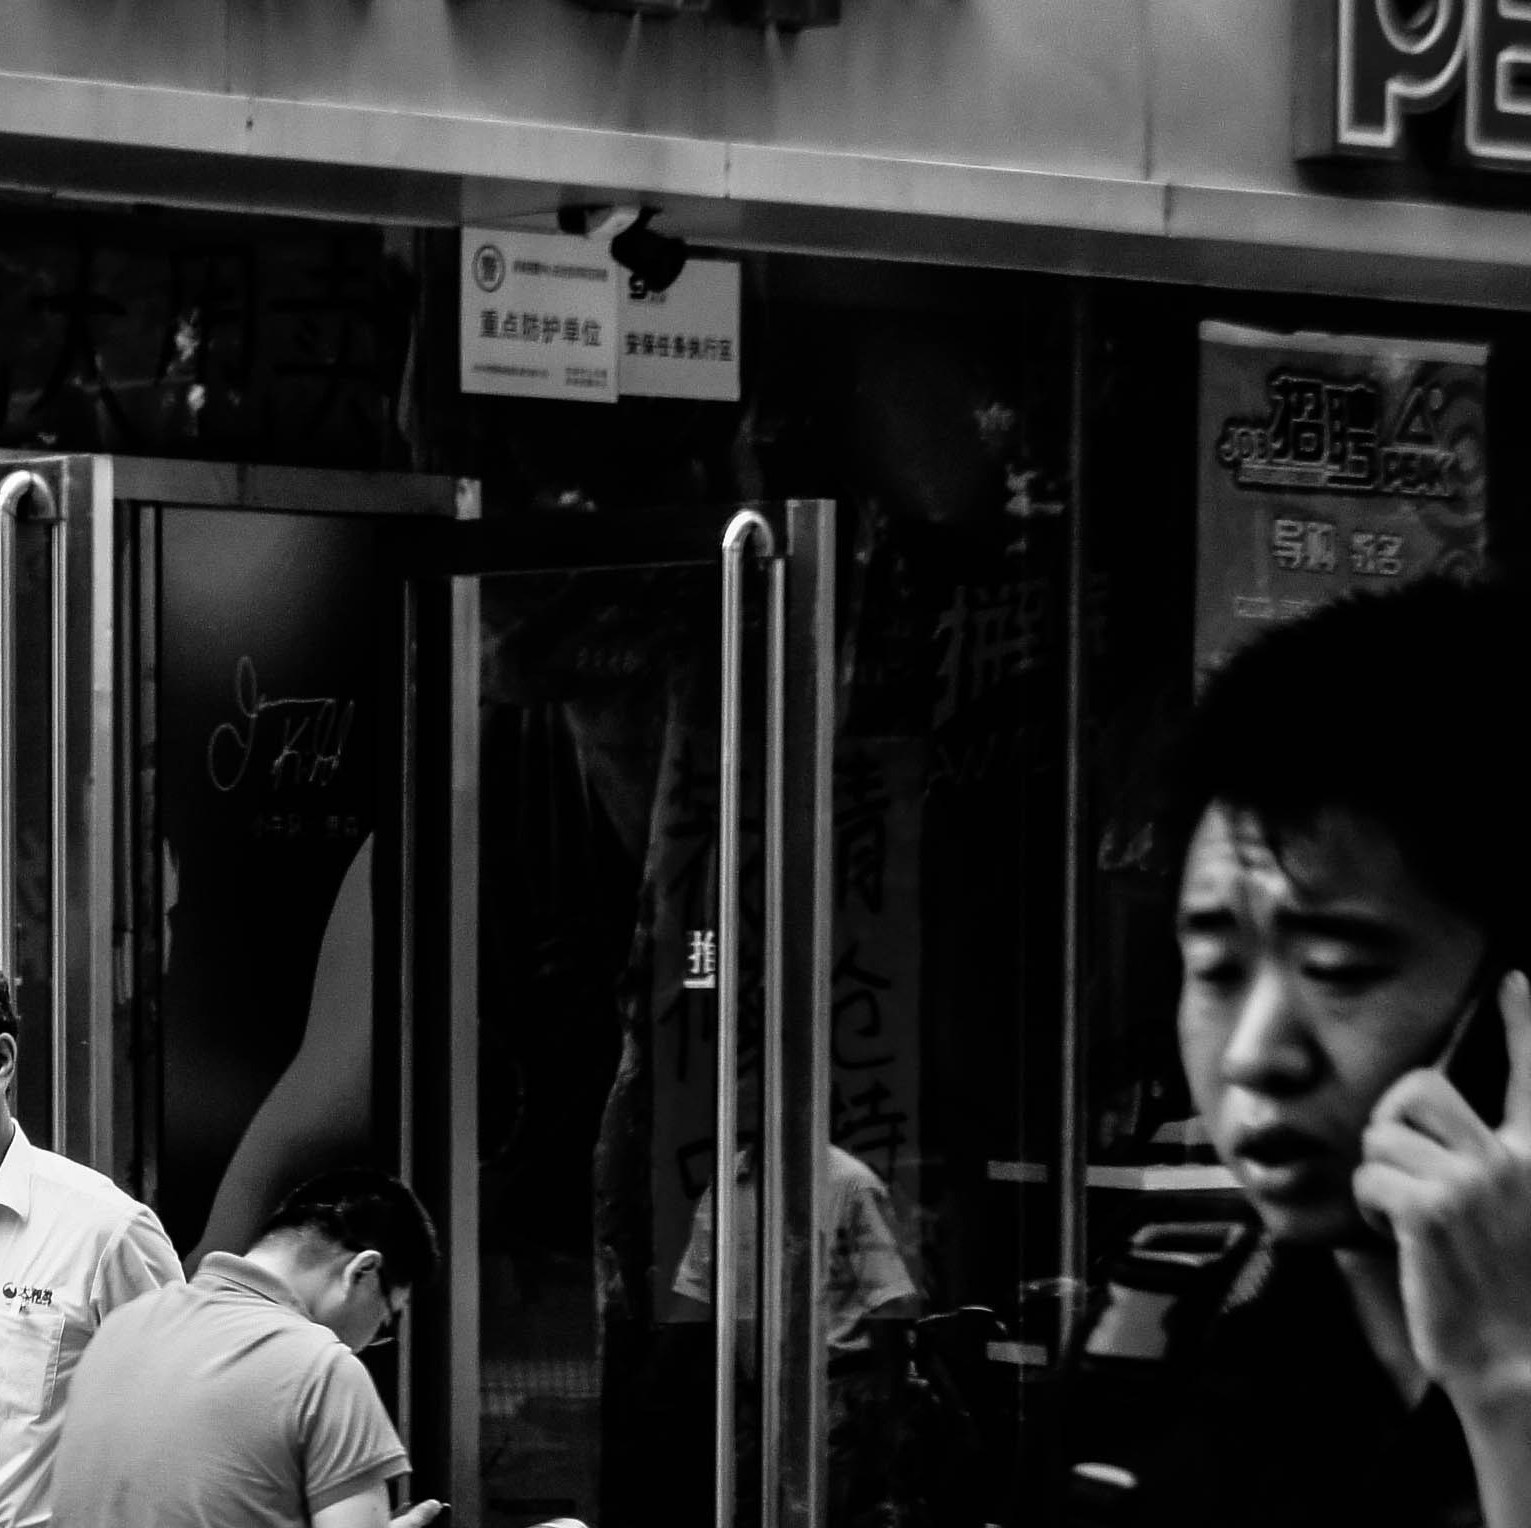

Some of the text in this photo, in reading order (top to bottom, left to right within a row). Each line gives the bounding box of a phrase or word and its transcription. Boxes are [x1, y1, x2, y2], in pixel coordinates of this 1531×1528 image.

[480, 309, 603, 347] 重点防护单位
[625, 333, 733, 362] 安保任务执行区
